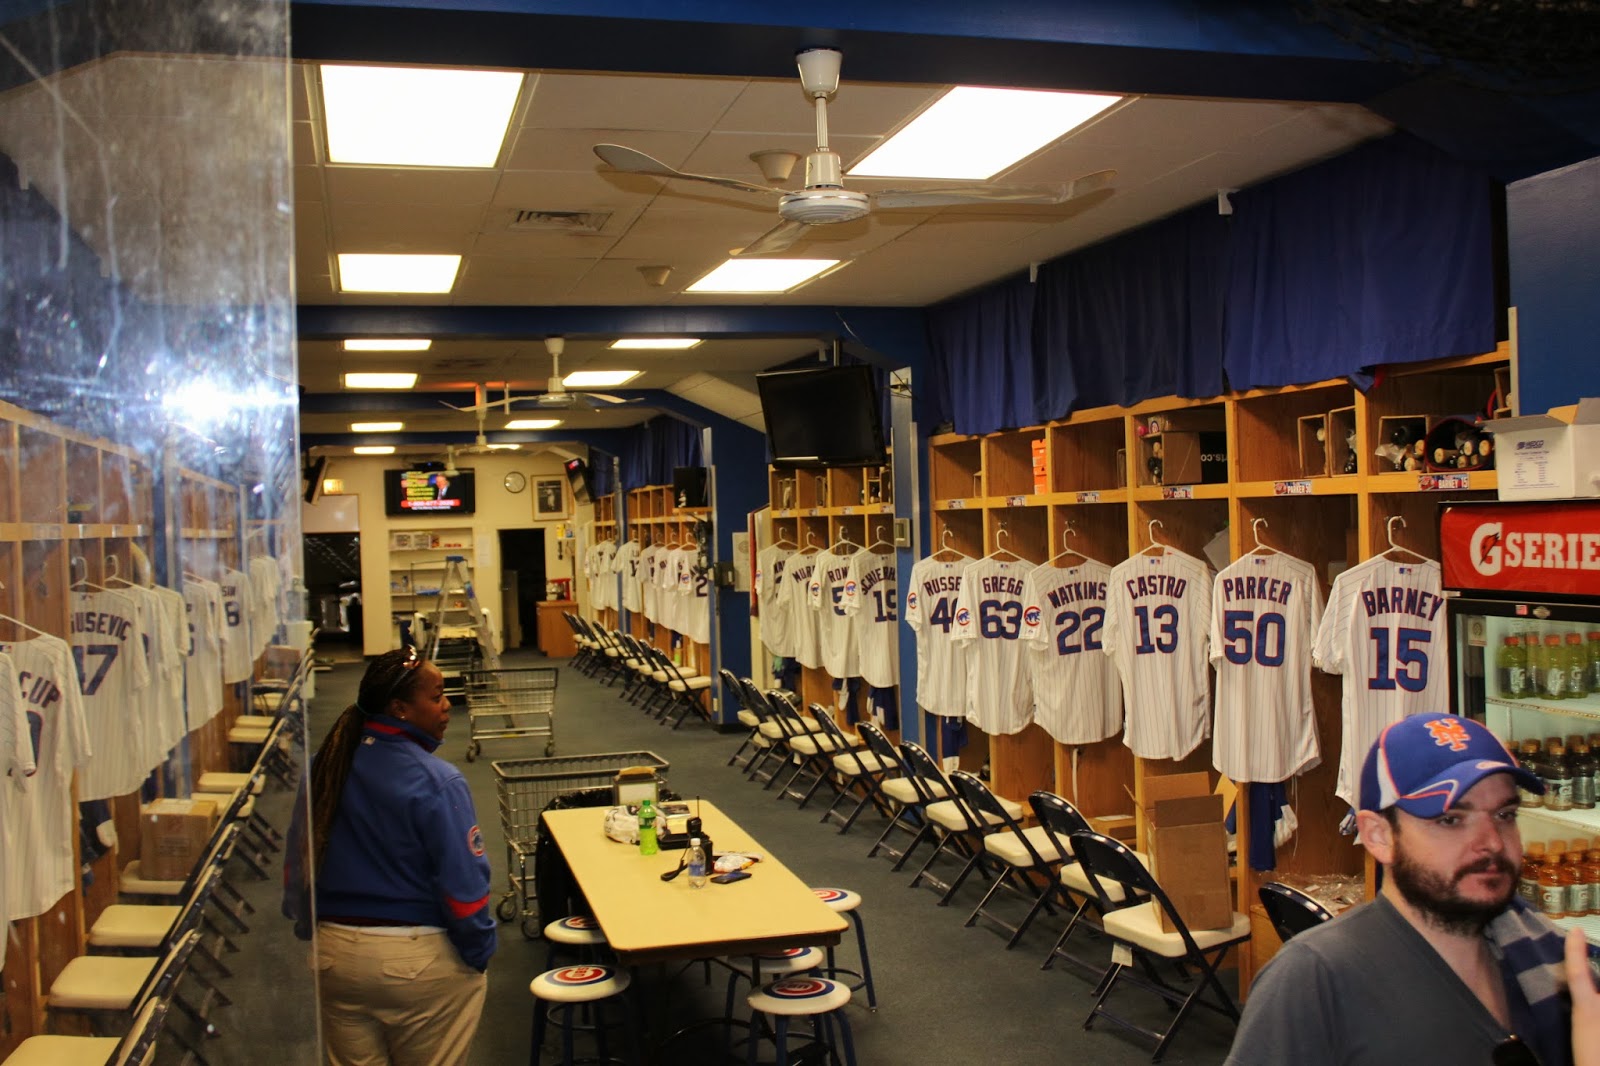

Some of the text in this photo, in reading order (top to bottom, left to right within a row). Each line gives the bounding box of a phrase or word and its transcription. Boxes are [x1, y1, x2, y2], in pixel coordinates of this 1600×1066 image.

[982, 576, 1025, 596] GREGG
[1047, 581, 1107, 609] WATKINS
[1126, 575, 1187, 600] CASTRO
[1223, 576, 1292, 605] PARKER
[1362, 586, 1444, 622] BARNEY
[979, 599, 1023, 640] 63
[1055, 606, 1106, 656] 22
[1134, 604, 1179, 655] 13
[1224, 610, 1286, 667] 50
[1368, 627, 1432, 693] 15
